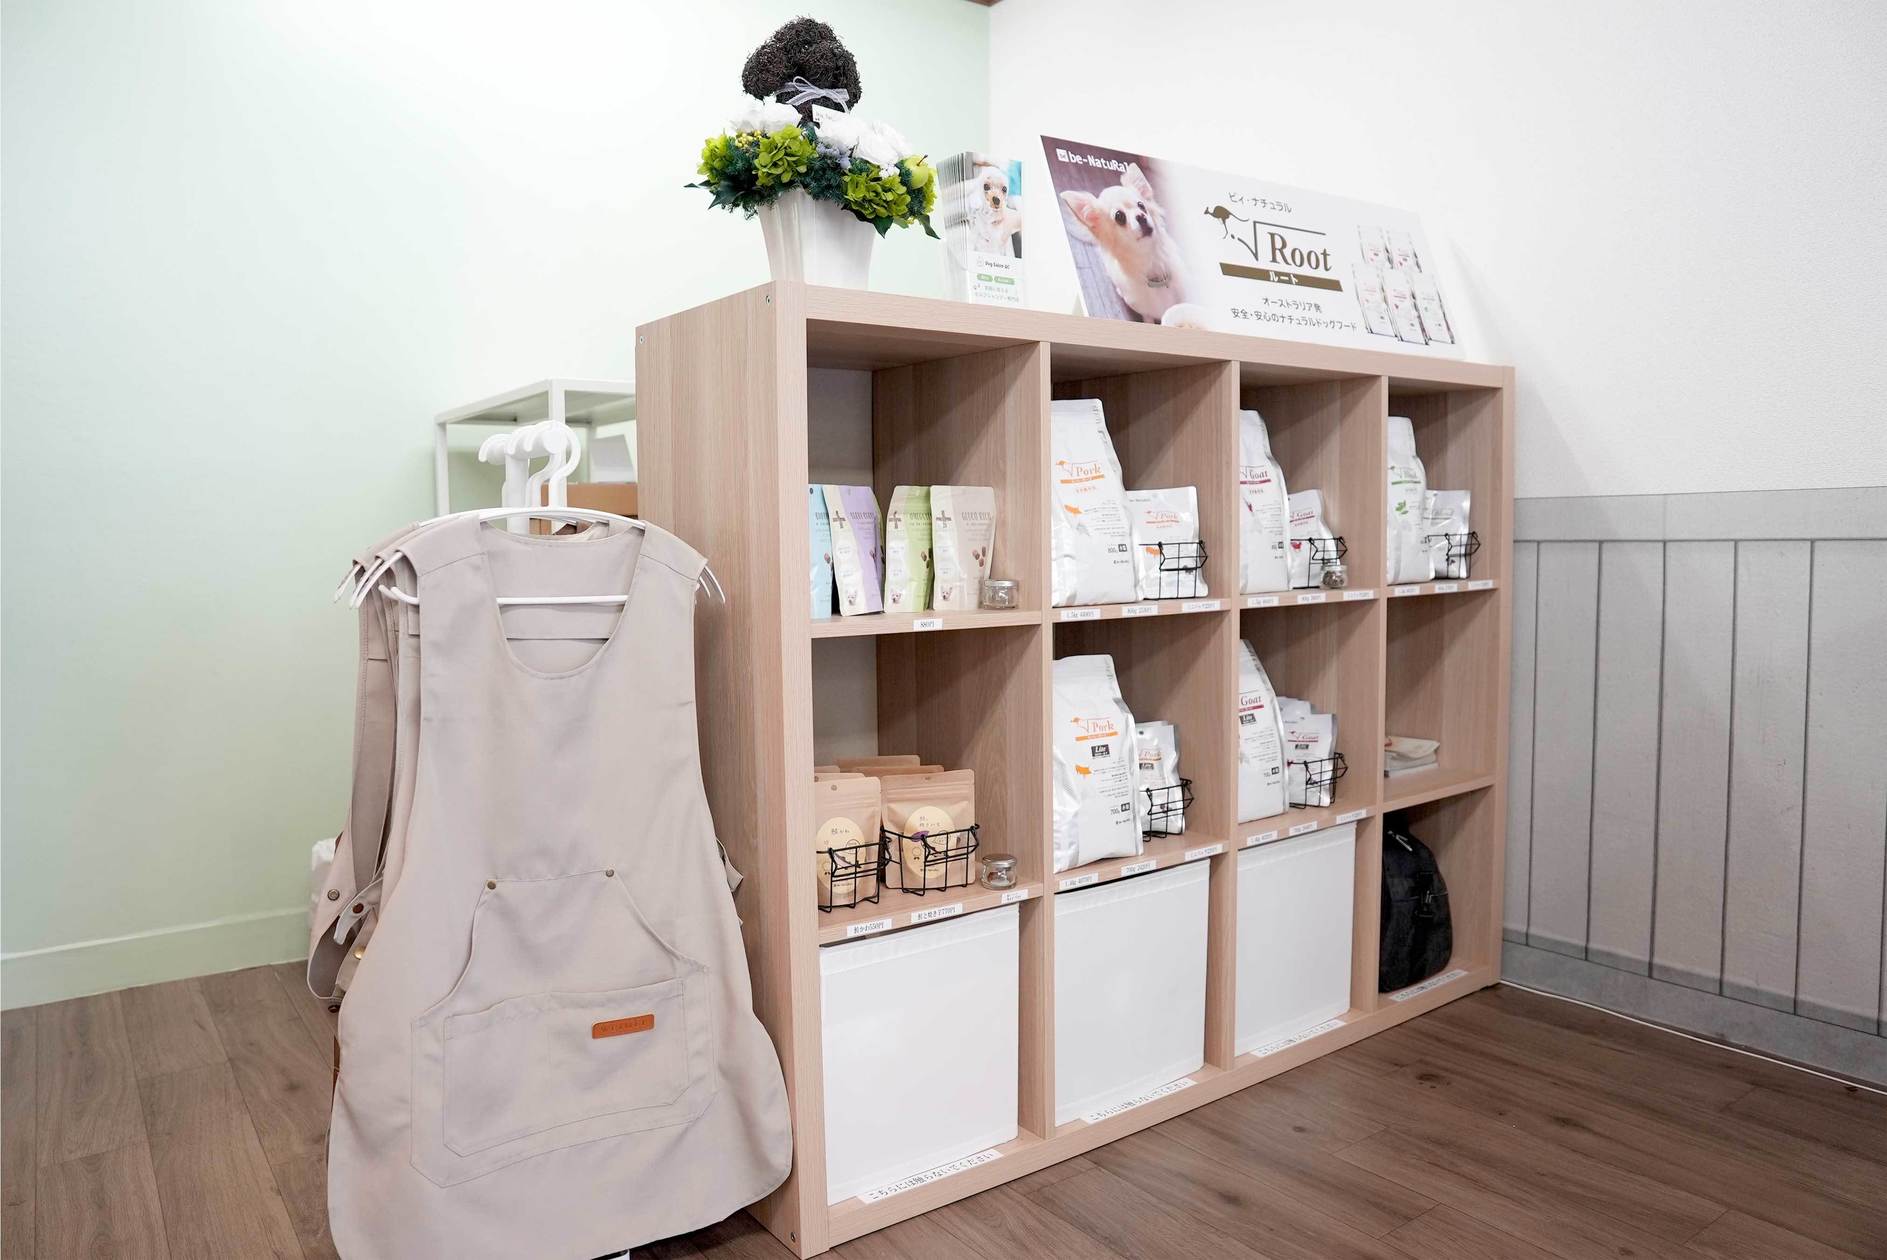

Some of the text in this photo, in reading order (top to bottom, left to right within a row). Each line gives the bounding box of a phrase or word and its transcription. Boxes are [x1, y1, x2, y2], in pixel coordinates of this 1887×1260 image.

[1267, 231, 1332, 272] Root
[1268, 271, 1299, 285] ルート
[1076, 463, 1102, 477] Pork
[1241, 694, 1262, 706] Goat
[1092, 719, 1115, 732] Pork
[869, 1152, 994, 1200] こちらには触らないでください
